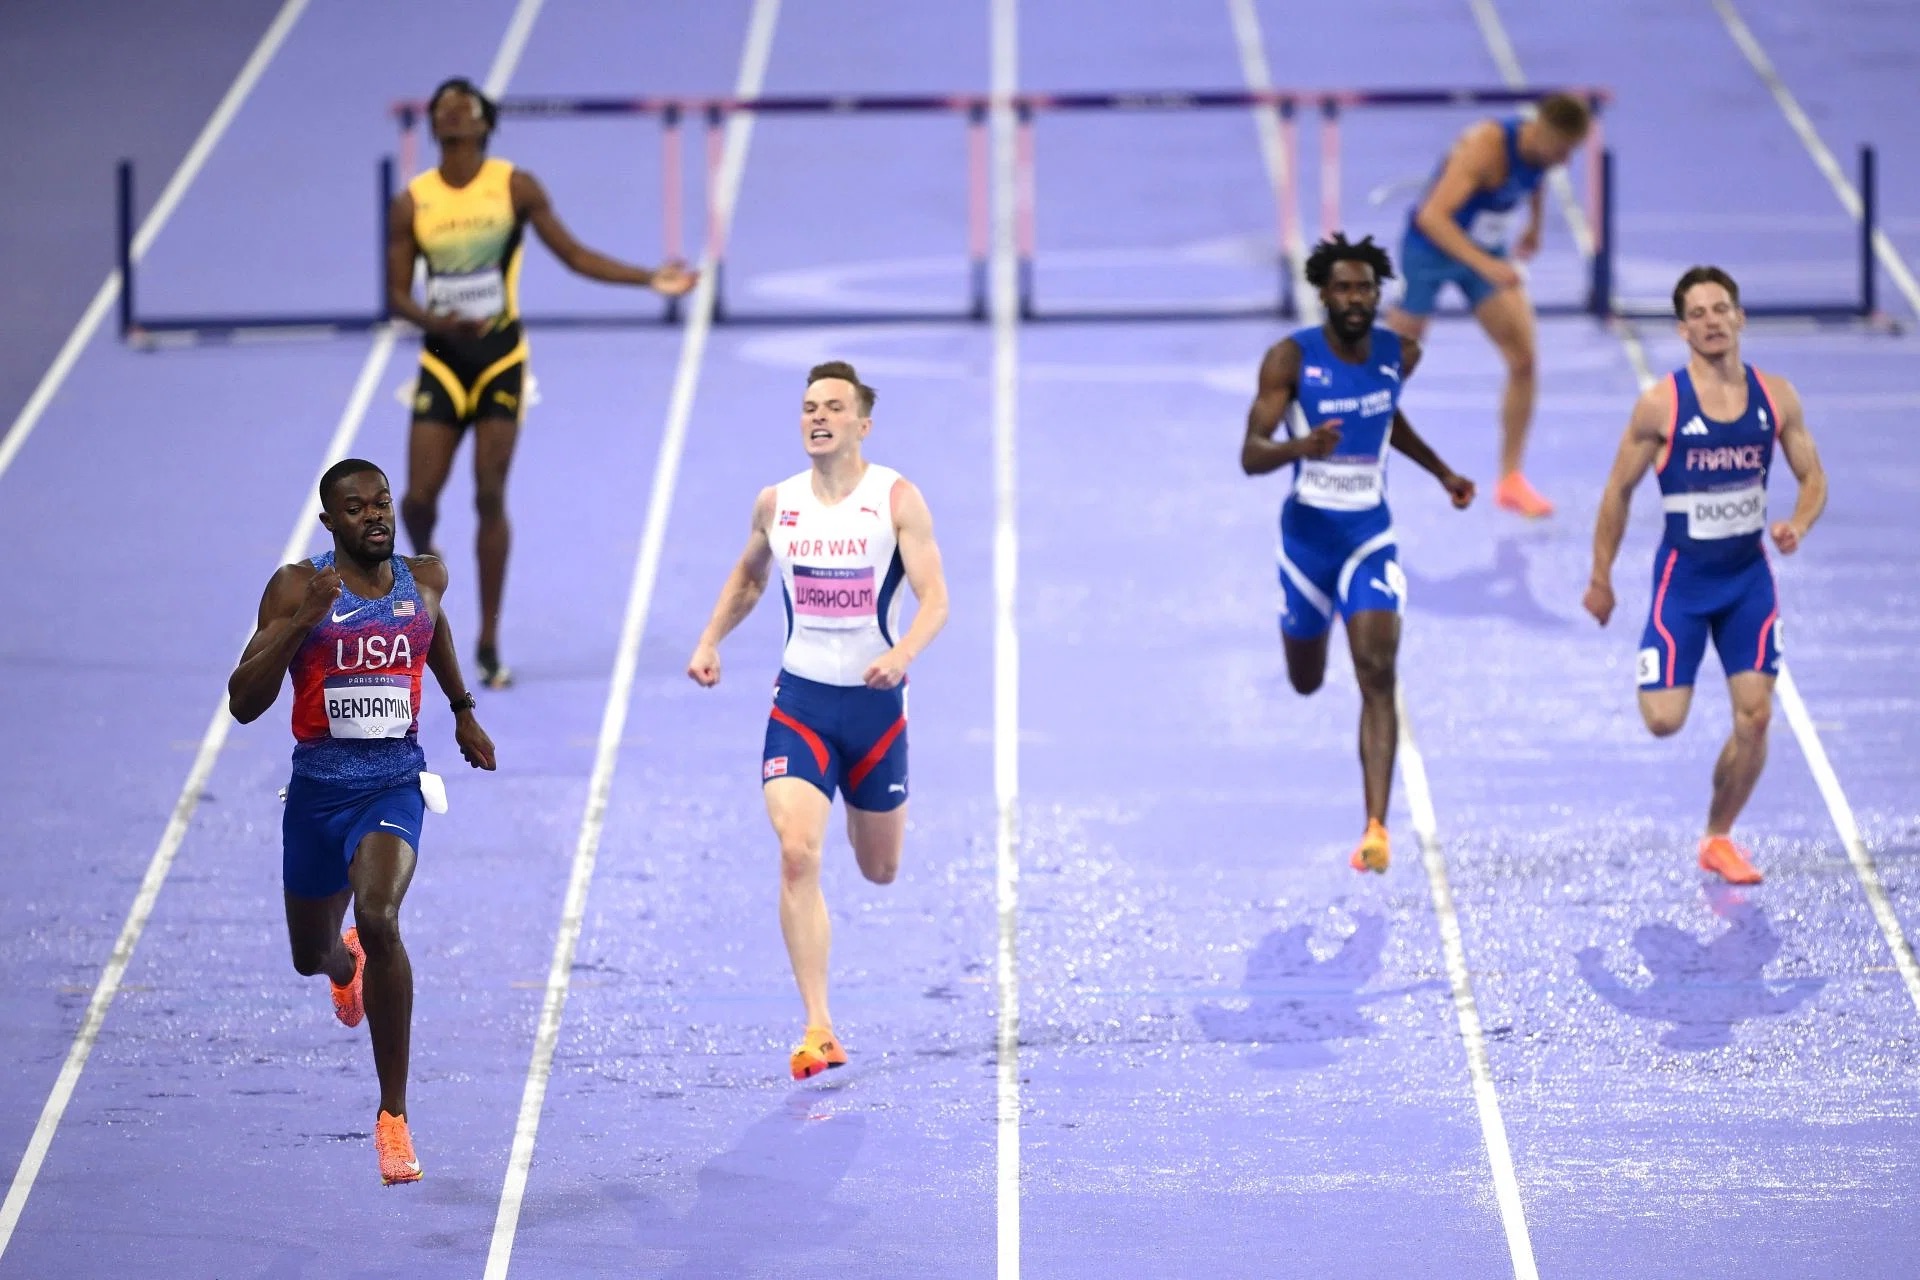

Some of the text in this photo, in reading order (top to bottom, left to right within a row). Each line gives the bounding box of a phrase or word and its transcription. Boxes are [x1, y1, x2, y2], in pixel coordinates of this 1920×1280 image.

[1686, 444, 1764, 471] FRANCE
[787, 537, 868, 557] NORWAY
[796, 586, 873, 608] WARHOLM
[336, 634, 412, 670] USA
[328, 697, 410, 719] BENJAMIN
